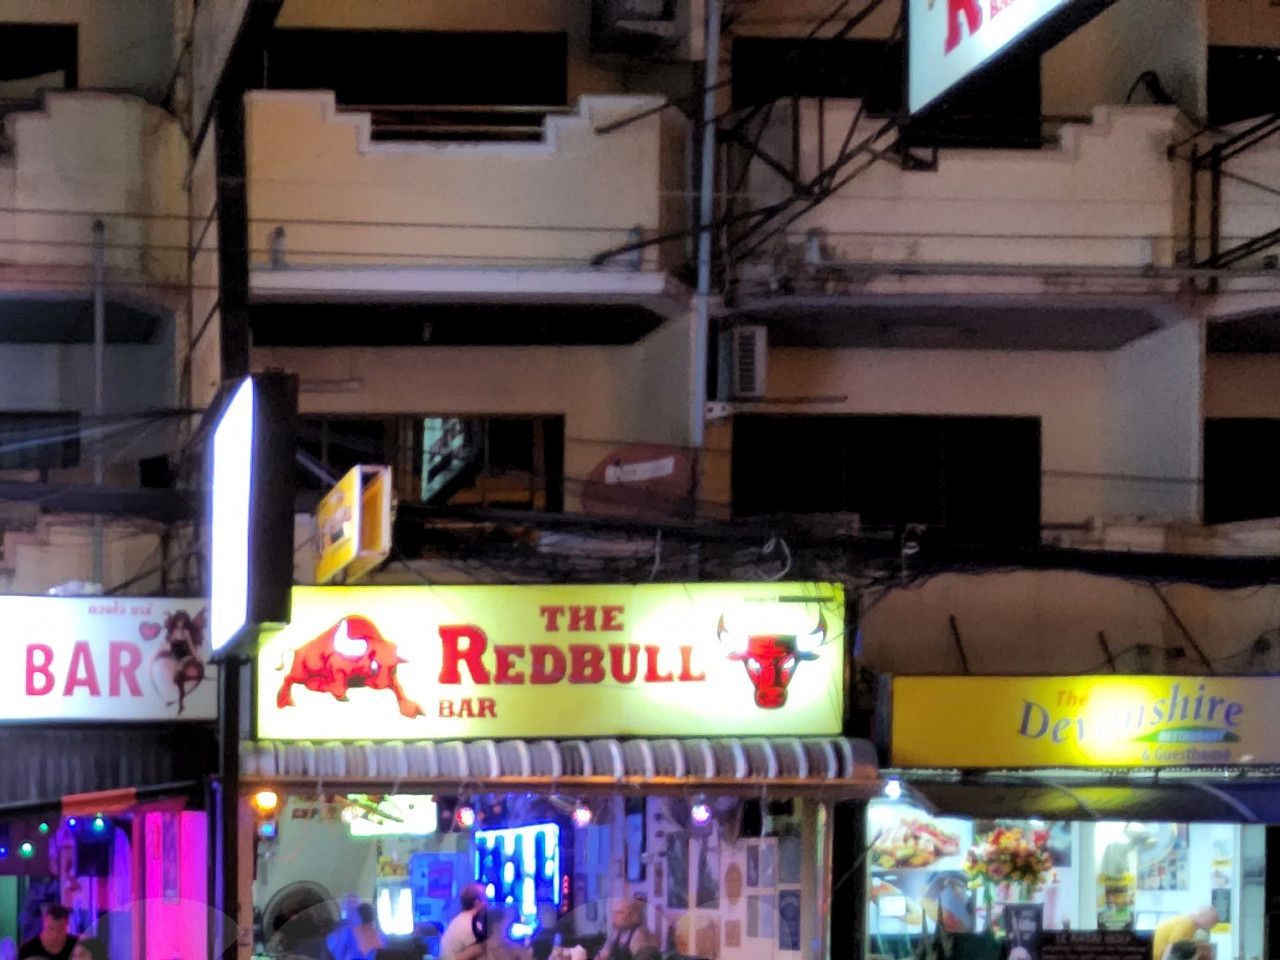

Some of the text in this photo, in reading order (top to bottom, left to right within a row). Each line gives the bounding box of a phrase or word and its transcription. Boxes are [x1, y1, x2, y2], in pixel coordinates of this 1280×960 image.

[539, 605, 625, 632] THE
[24, 640, 144, 697] BAR
[438, 624, 706, 685] REDBULL
[438, 697, 497, 718] BAR
[1018, 683, 1244, 744] Devnshire
[1056, 689, 1089, 707] The
